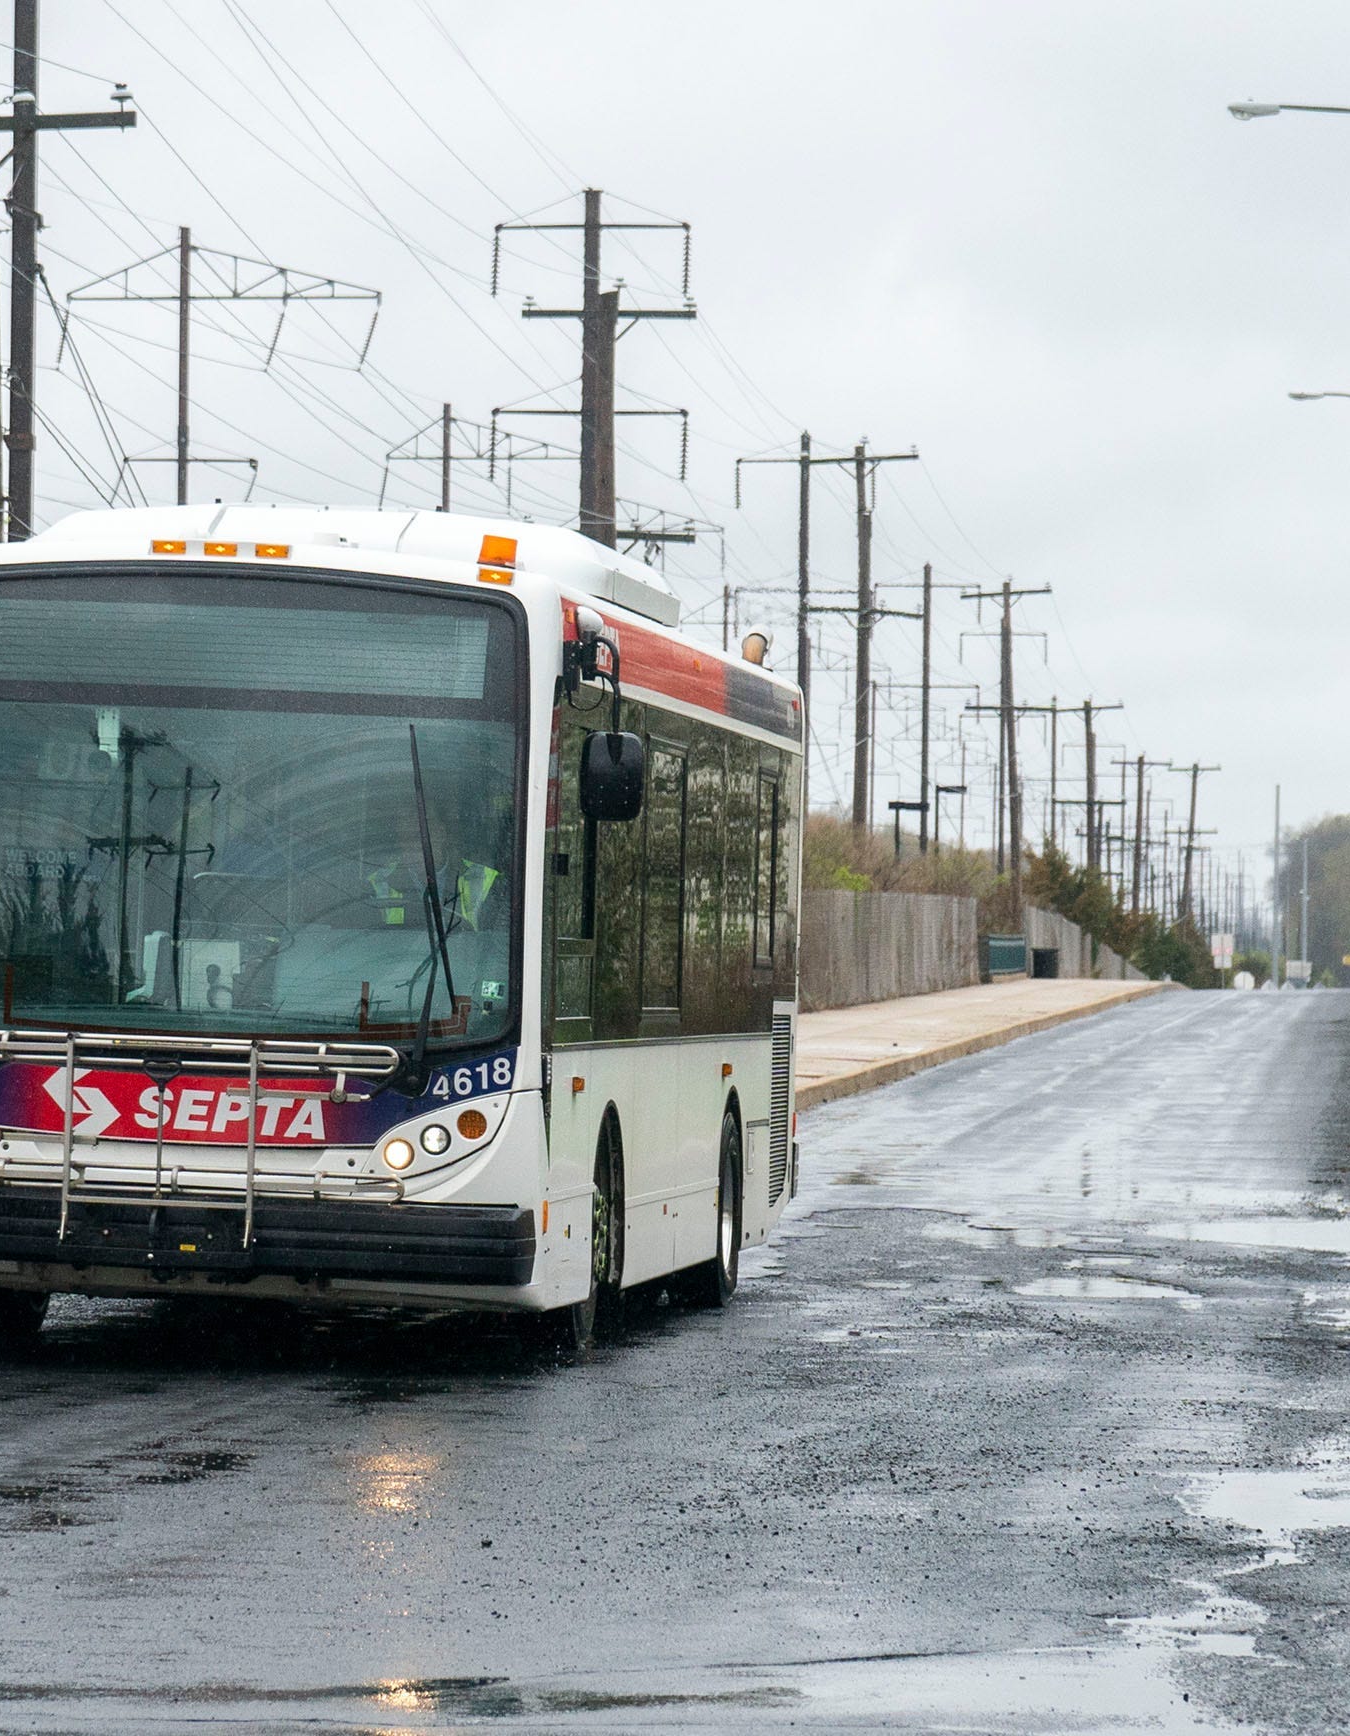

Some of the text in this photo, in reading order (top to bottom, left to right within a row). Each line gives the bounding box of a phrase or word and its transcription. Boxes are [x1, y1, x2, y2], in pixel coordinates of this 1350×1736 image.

[6, 848, 77, 863] WELCOME
[6, 863, 65, 878] ABOARD
[432, 1057, 511, 1100] 4618
[134, 1086, 326, 1140] SEPTA
